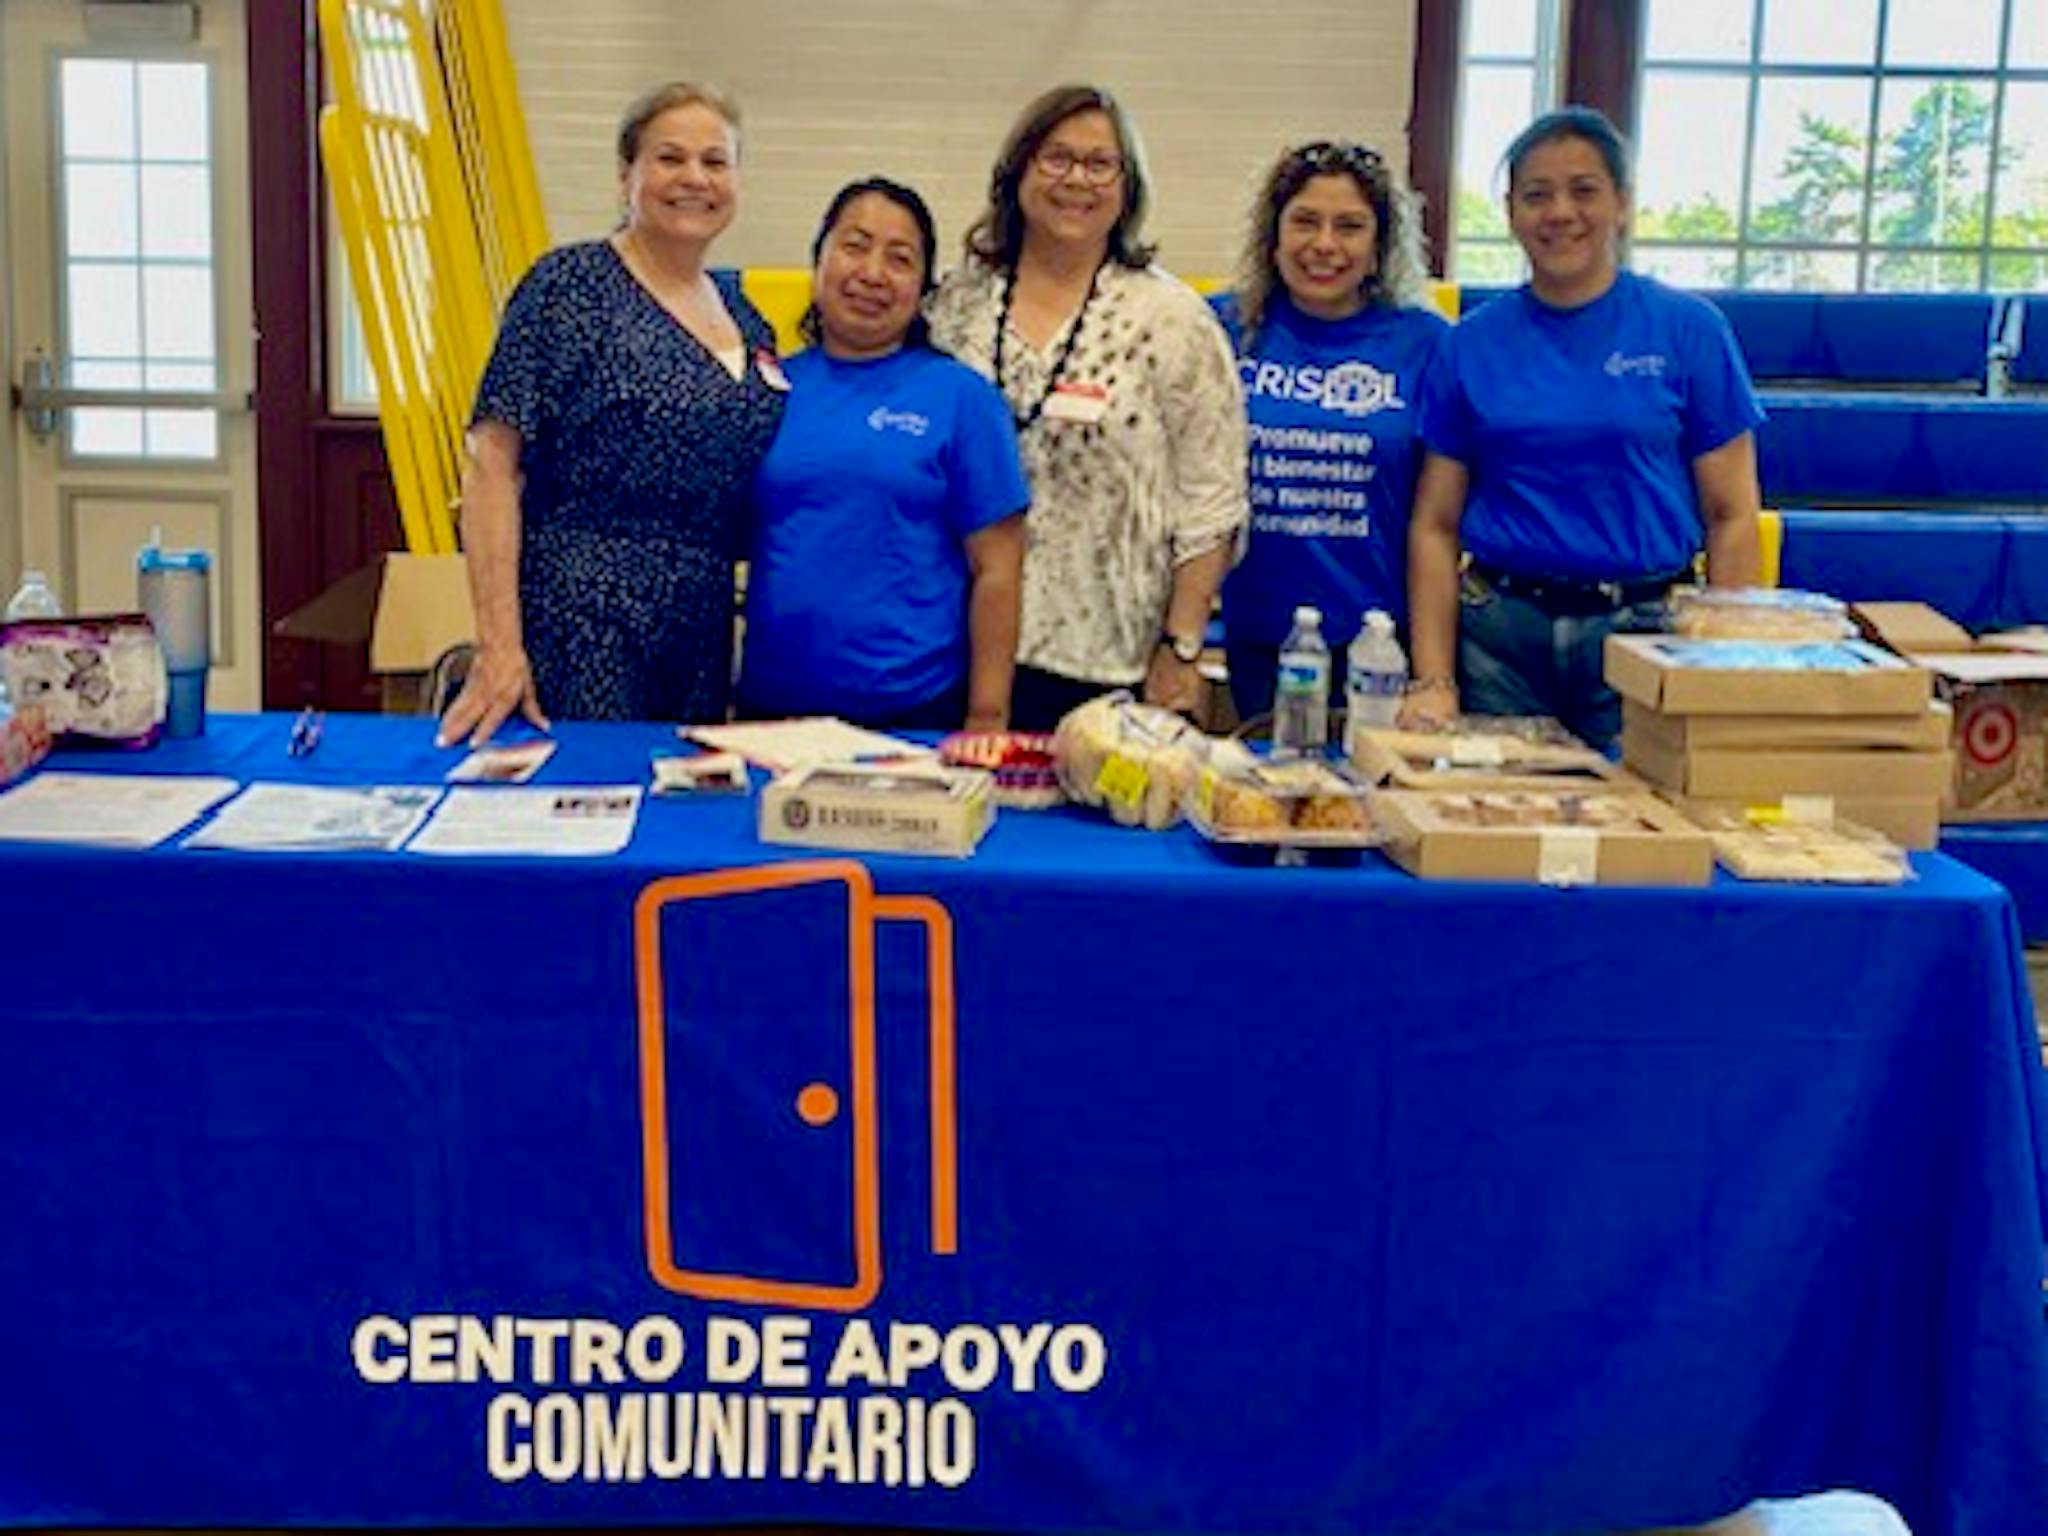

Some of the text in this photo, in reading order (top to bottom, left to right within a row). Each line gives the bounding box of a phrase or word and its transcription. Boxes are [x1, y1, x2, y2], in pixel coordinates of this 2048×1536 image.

[352, 1315, 1106, 1393] CENTRO DE APOYO
[487, 1392, 975, 1487] COMUNITARIO
